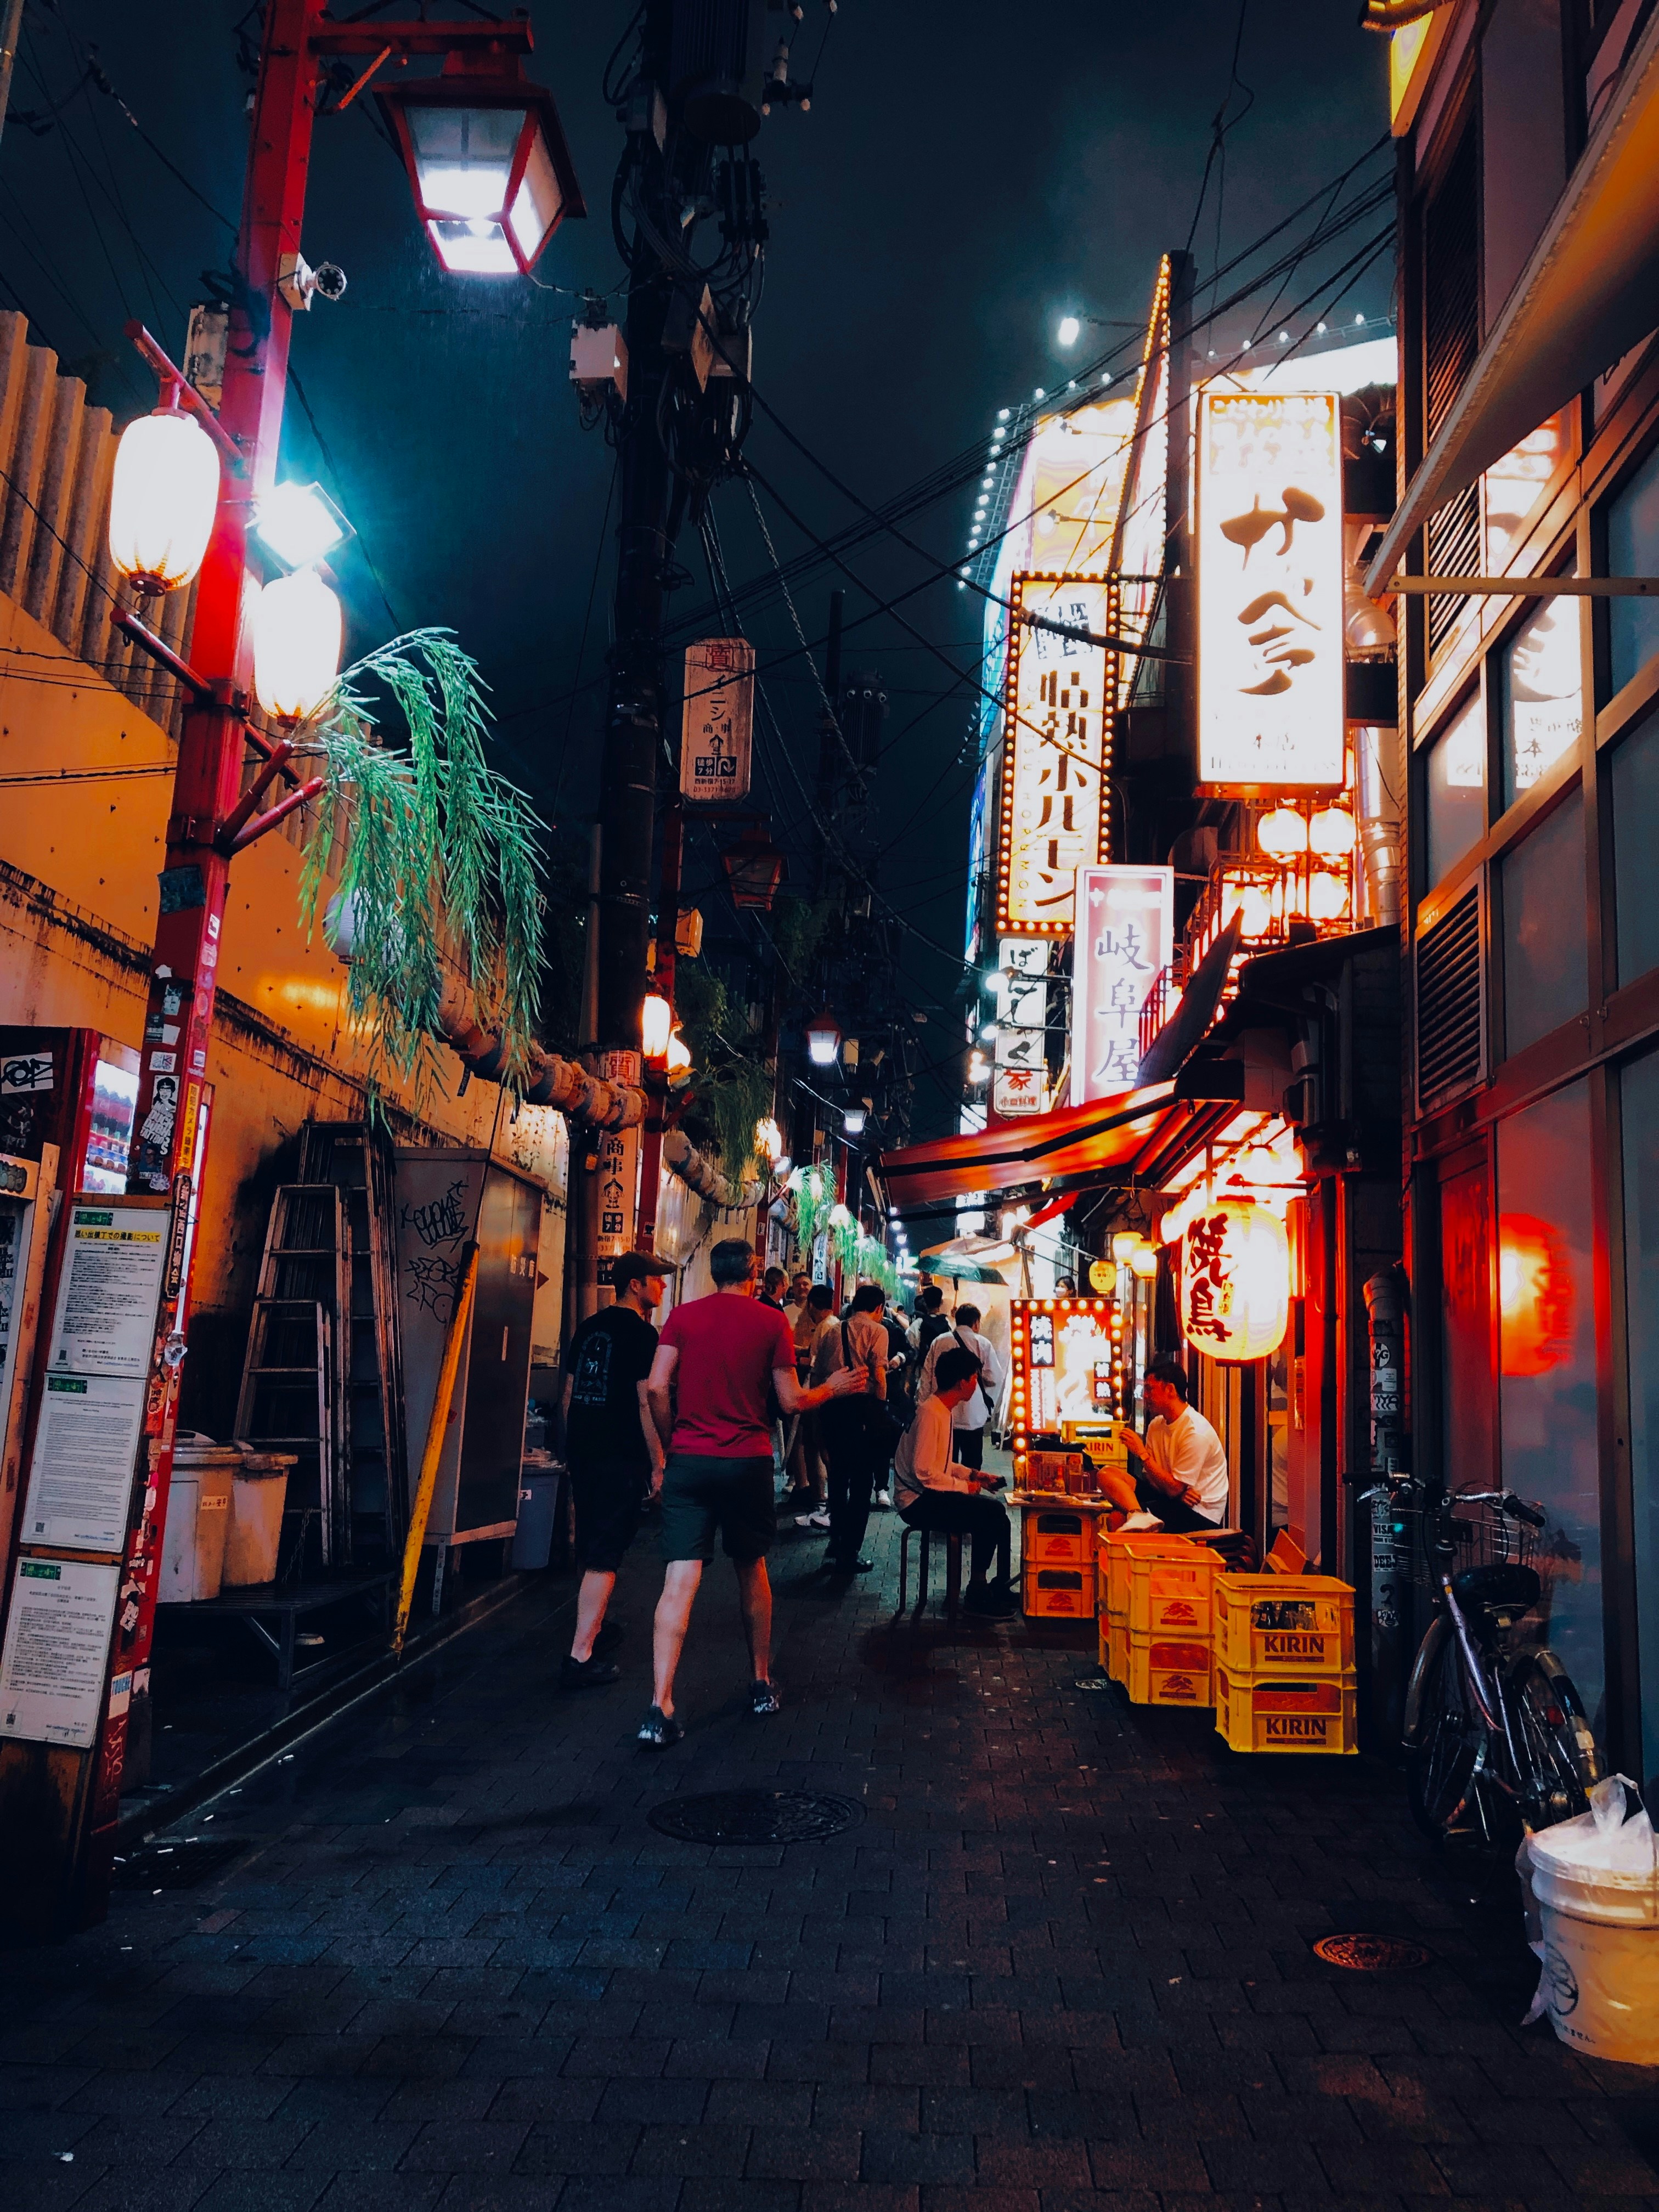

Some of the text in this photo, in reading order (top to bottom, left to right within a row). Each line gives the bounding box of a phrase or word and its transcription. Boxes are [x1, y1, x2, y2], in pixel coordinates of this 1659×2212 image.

[1096, 923, 1150, 1082] 岐阜屋
[999, 1094, 1037, 1108] 小皿料理
[605, 1137, 624, 1175] 商事
[75, 1230, 160, 1242] 思い出横丁での撮影について
[1185, 1212, 1238, 1342] 焼鳥
[1085, 1443, 1113, 1452] KIRIN
[1264, 1635, 1324, 1654] KIRIN
[1266, 1718, 1327, 1736] KIRIN
